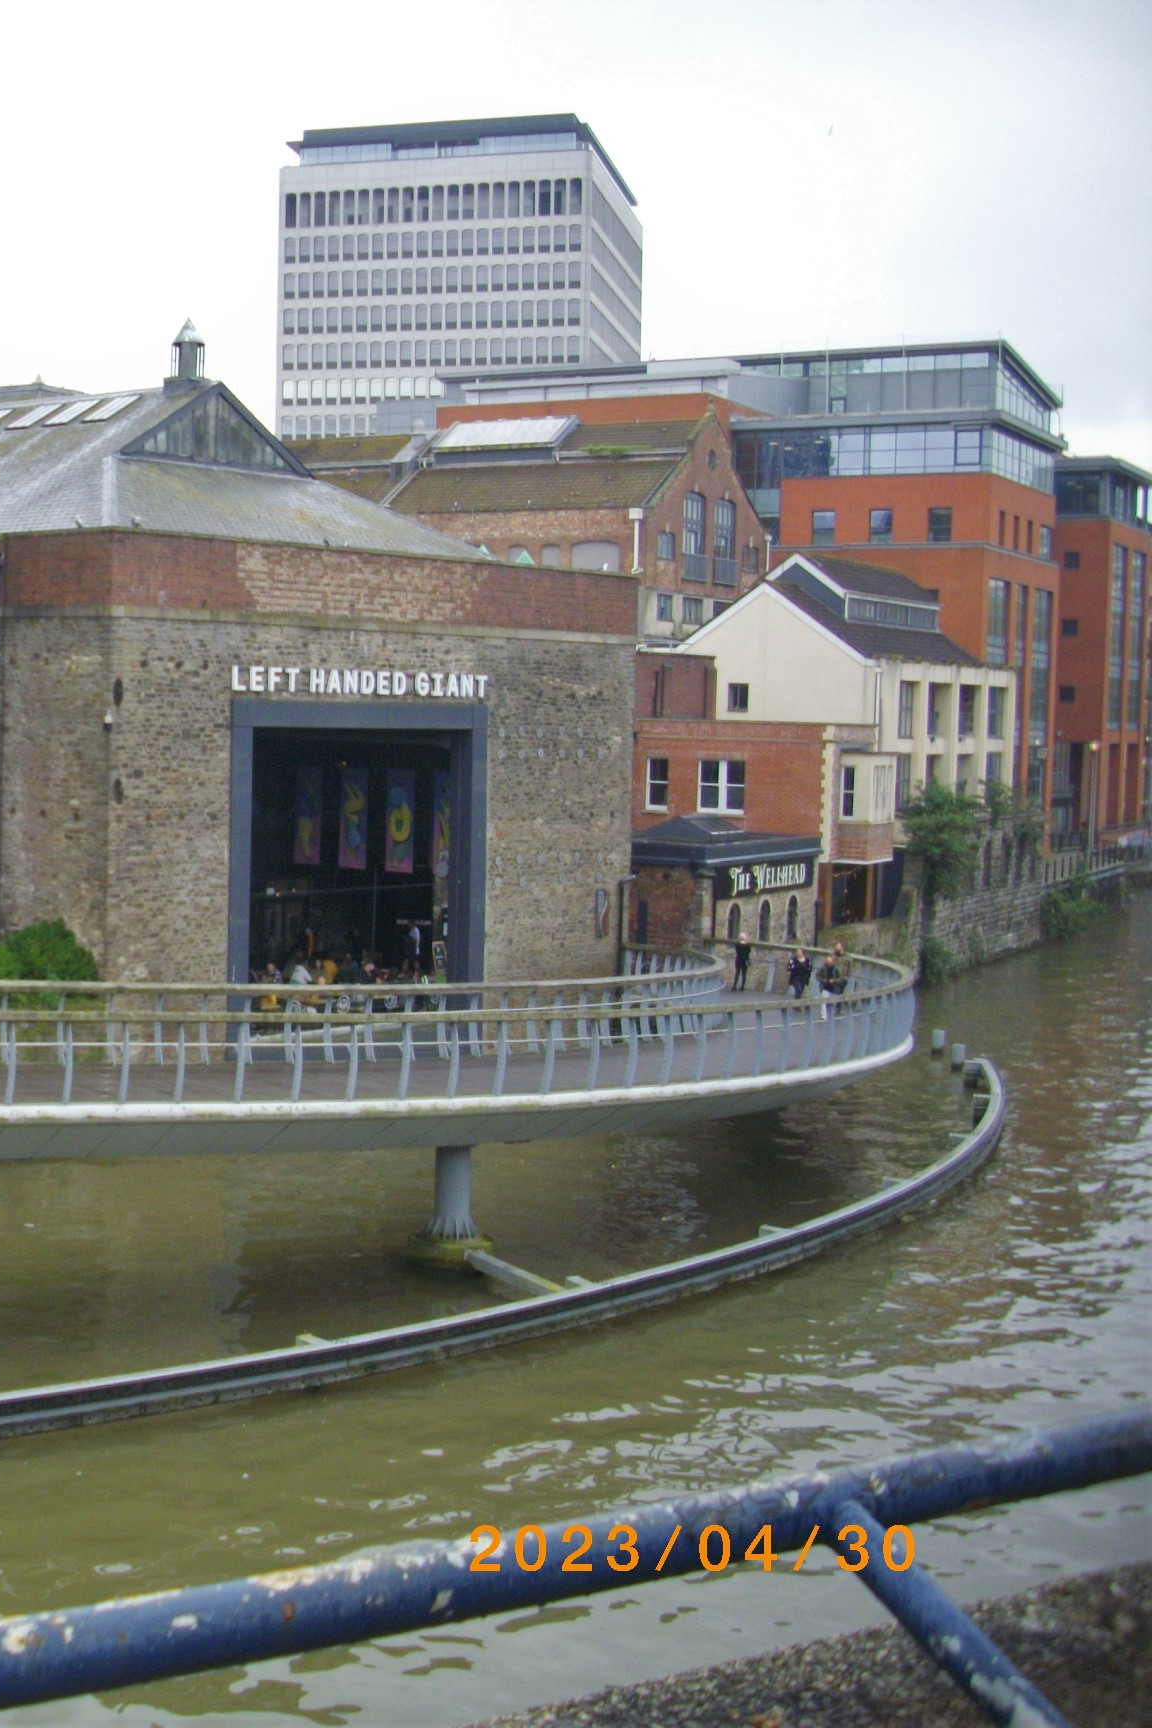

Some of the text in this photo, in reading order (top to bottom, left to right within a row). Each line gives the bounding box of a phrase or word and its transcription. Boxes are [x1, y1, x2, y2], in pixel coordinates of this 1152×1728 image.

[231, 664, 488, 698] LEFT HANDED GIANT
